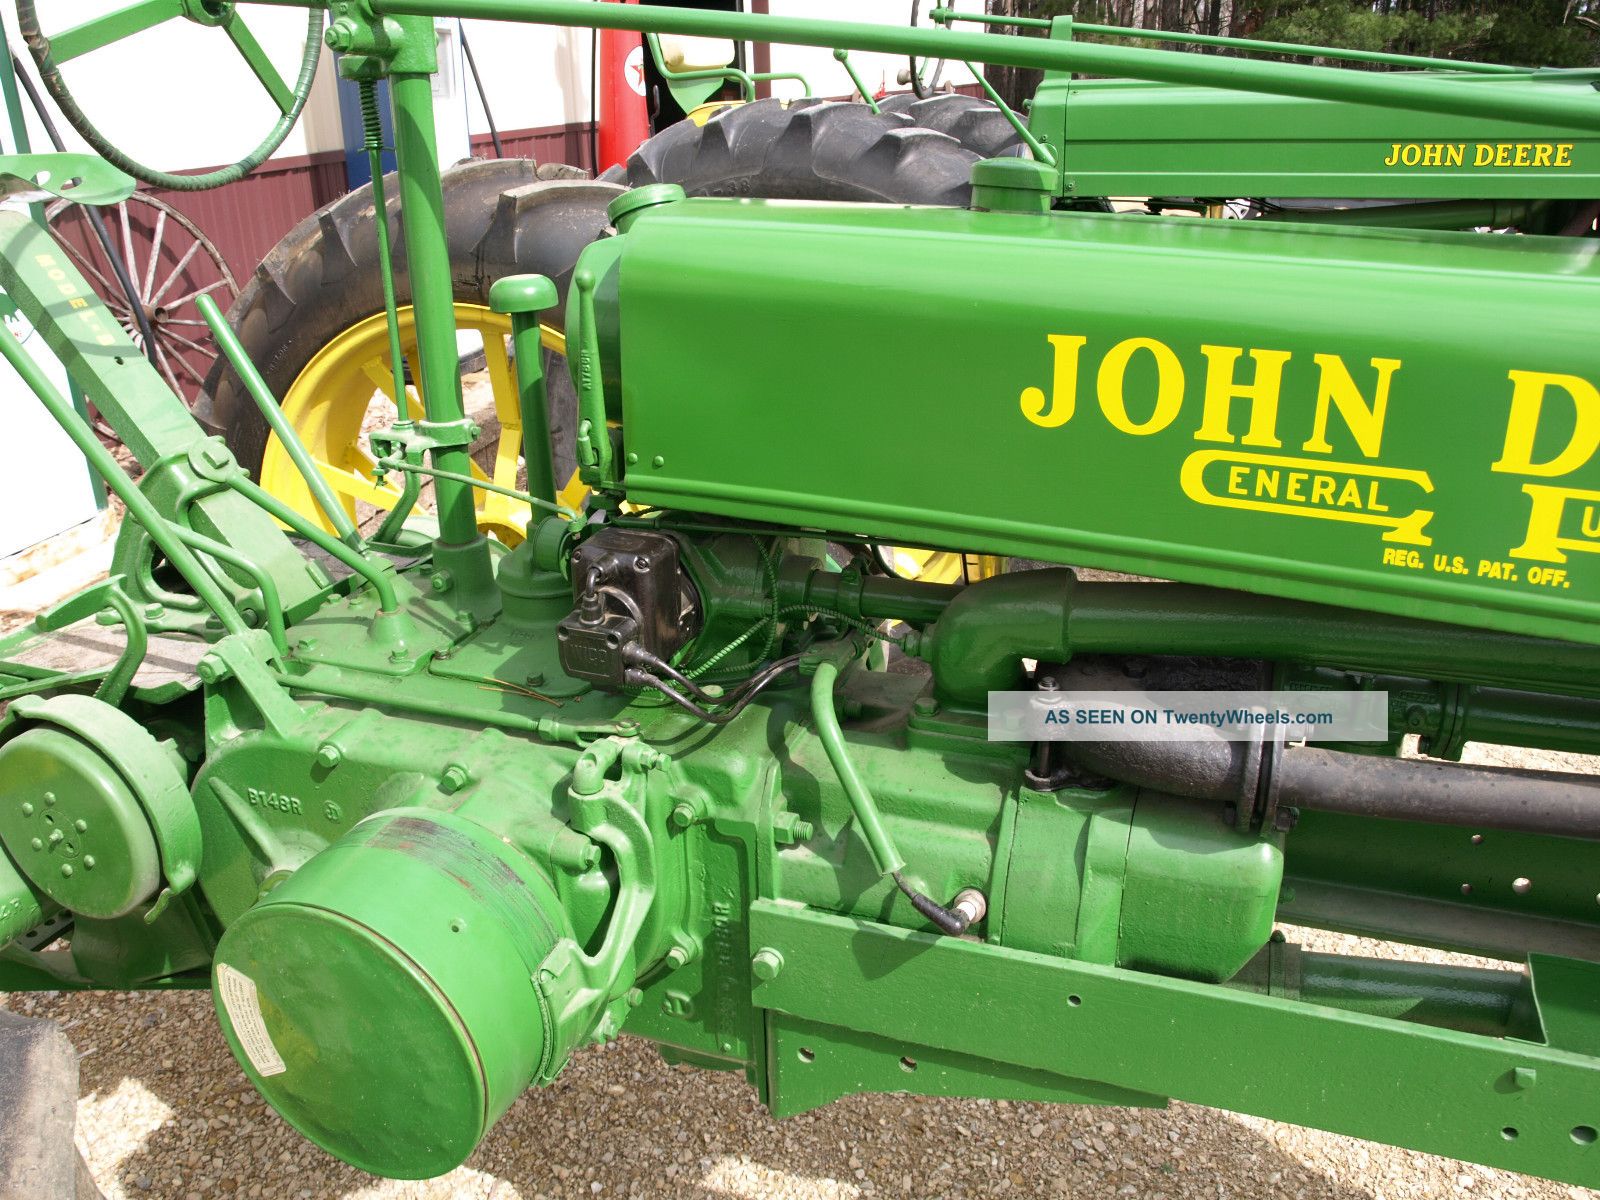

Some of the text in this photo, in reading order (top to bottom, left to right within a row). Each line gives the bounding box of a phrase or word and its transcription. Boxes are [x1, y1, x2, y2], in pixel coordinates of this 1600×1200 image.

[1384, 143, 1574, 168] JOHN DEERE
[1020, 334, 1402, 458] JOHN
[1180, 449, 1434, 547] GENERAL
[1382, 548, 1570, 588] REG. U.S. PAT. OFF.
